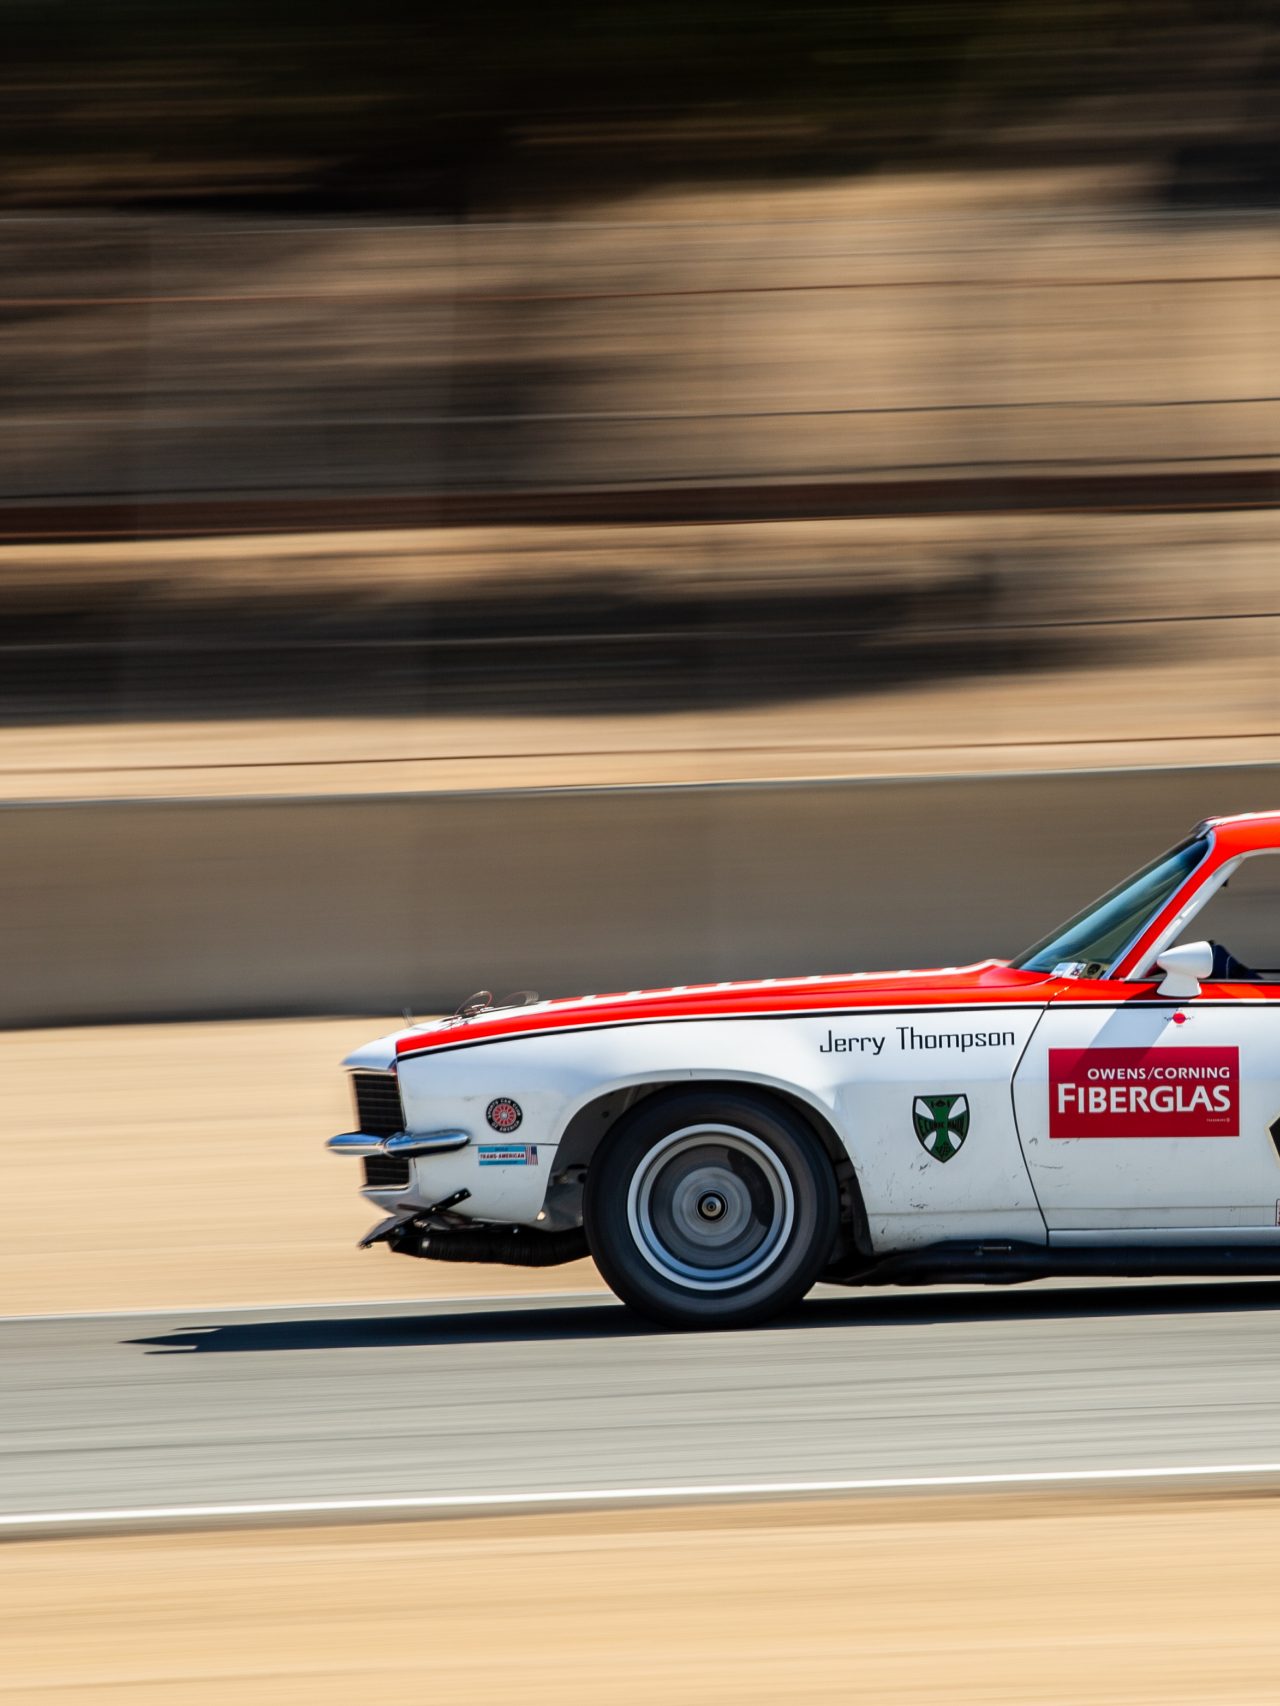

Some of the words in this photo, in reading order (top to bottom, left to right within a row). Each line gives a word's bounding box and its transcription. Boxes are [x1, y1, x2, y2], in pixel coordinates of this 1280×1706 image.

[819, 1029, 886, 1056] Jerry
[896, 1026, 1015, 1053] Thompson
[1087, 1066, 1231, 1080] OWENS/CORNING
[1057, 1083, 1231, 1114] FIBERGLAS
